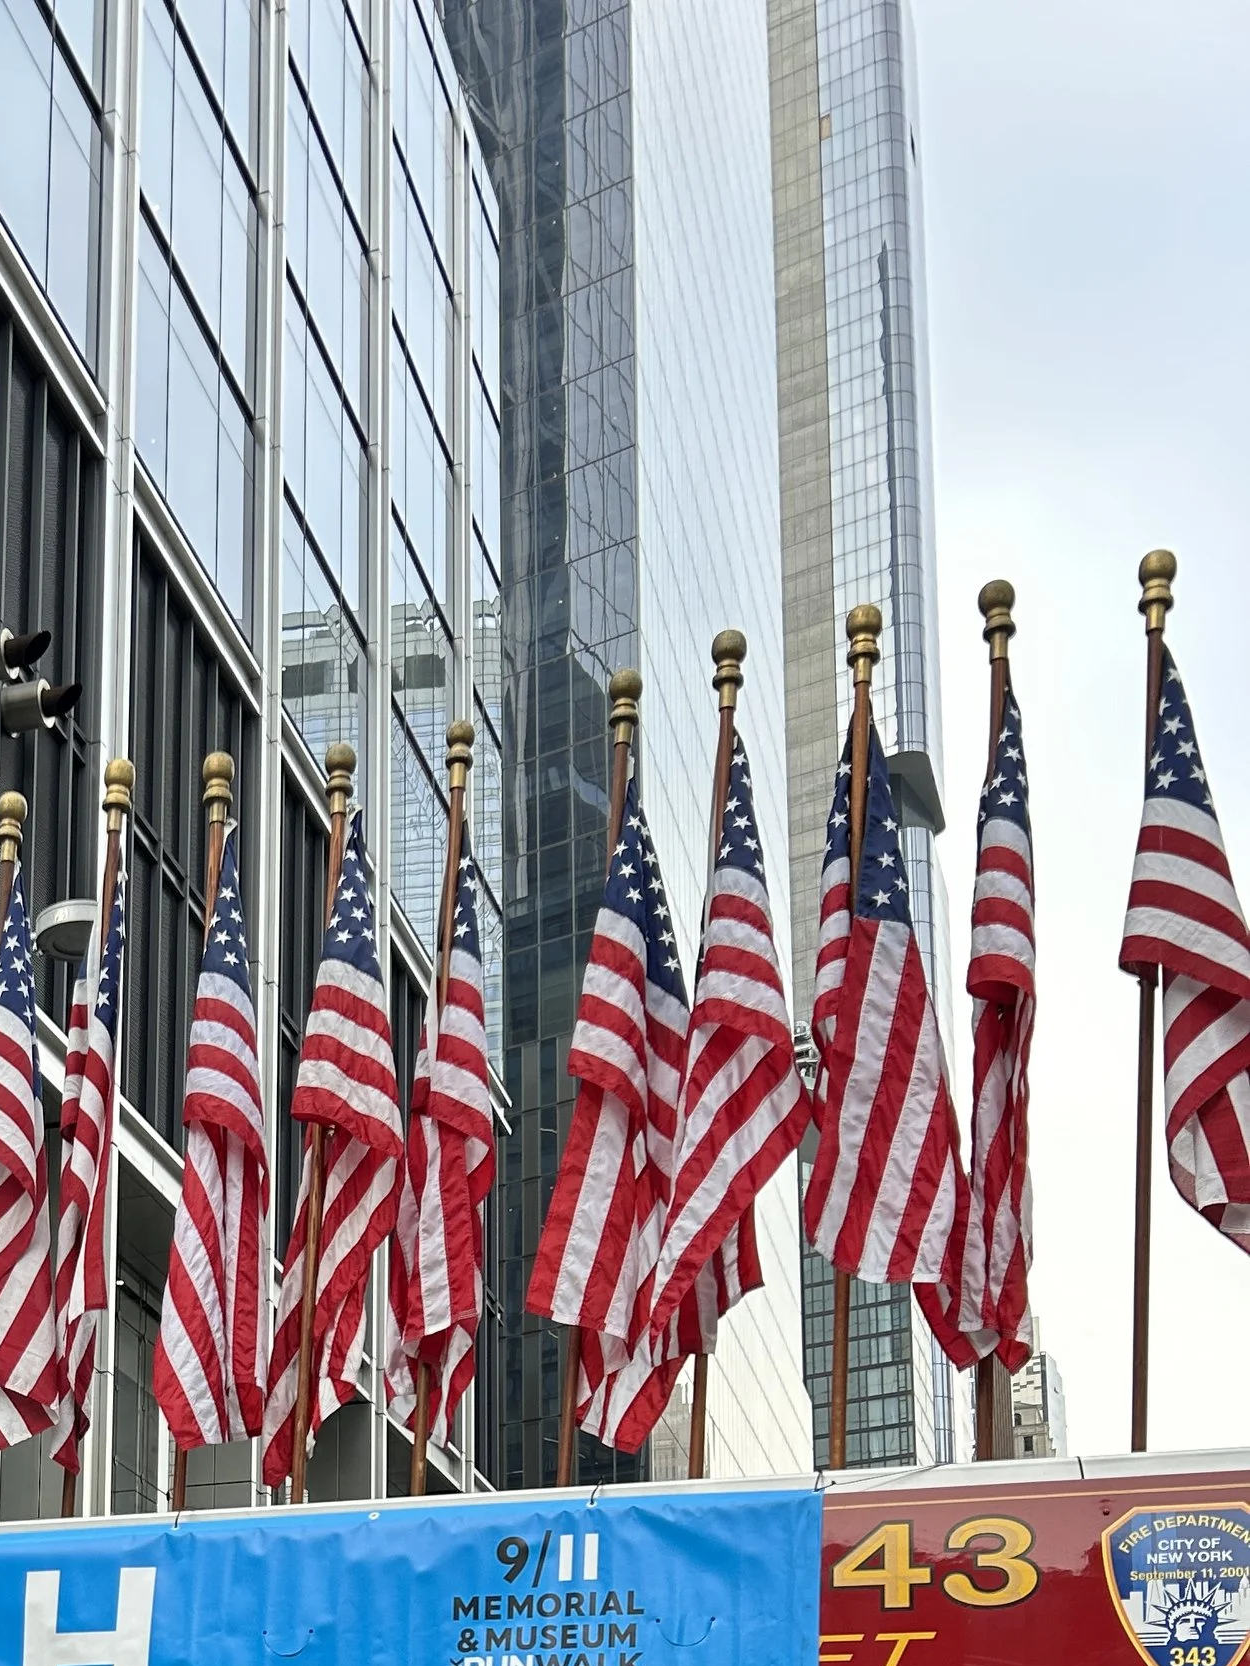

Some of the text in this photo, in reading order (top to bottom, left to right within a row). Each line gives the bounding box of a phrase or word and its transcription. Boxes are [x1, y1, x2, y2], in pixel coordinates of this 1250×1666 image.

[1118, 1515, 1250, 1554] FIRE DEPARTMEN
[1158, 1537, 1221, 1551] CITY OF
[496, 1529, 600, 1588] 9/11
[1146, 1550, 1233, 1565] NEW YORK
[1130, 1566, 1250, 1581] September 11, 2001
[452, 1590, 645, 1621] MEMORIAL
[457, 1623, 637, 1653] & MUSEUM
